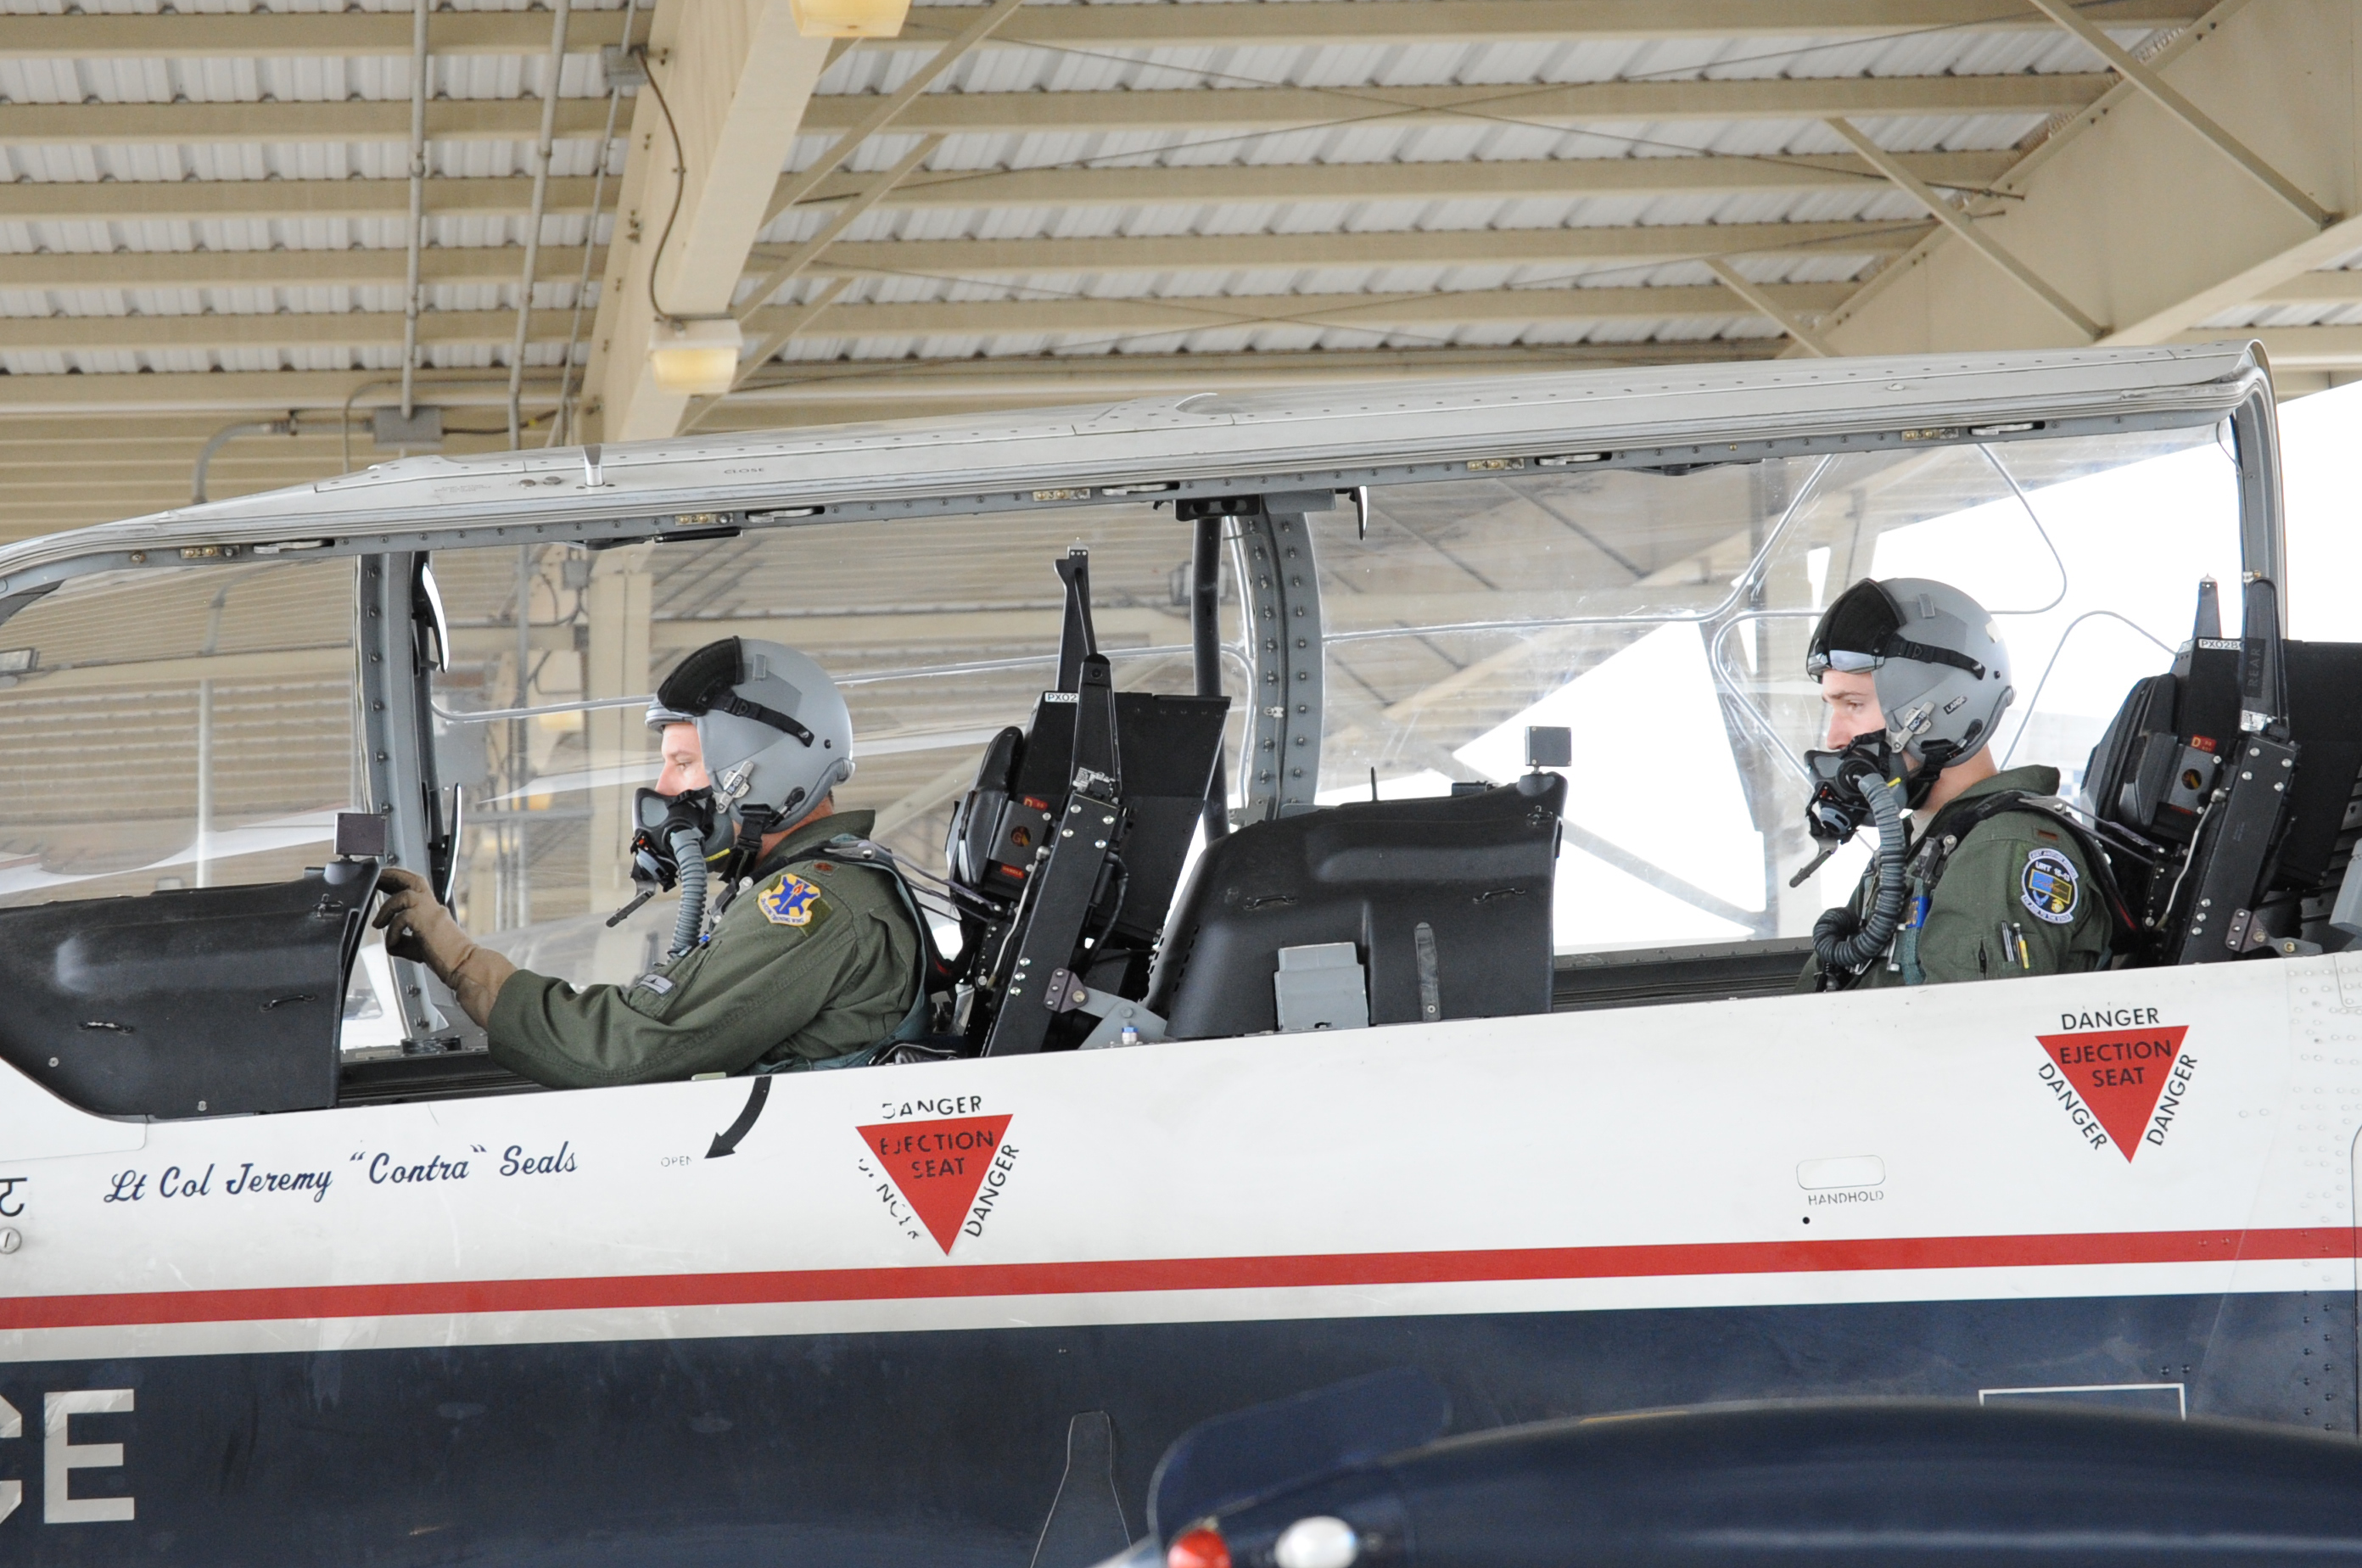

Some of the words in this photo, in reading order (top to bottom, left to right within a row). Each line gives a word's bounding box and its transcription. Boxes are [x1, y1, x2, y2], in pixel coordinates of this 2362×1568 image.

[2247, 647, 2262, 687] REAR
[2062, 1007, 2160, 1030] DANGER
[2059, 1039, 2172, 1064] EJECTION
[2091, 1067, 2145, 1087] SEAT
[2038, 1062, 2107, 1151] DANGER
[2146, 1054, 2198, 1146] DANGER
[880, 1130, 994, 1155] EJECTION
[104, 1169, 148, 1203] Lt
[159, 1163, 215, 1198] Col
[226, 1162, 333, 1203] Jeremy
[349, 1144, 487, 1184] “Contra”
[499, 1140, 578, 1177] Seals
[911, 1157, 965, 1179] SEAT
[964, 1144, 1020, 1237] DANGER
[1808, 1190, 1884, 1206] HANDHOLD
[0, 1388, 135, 1524] E
